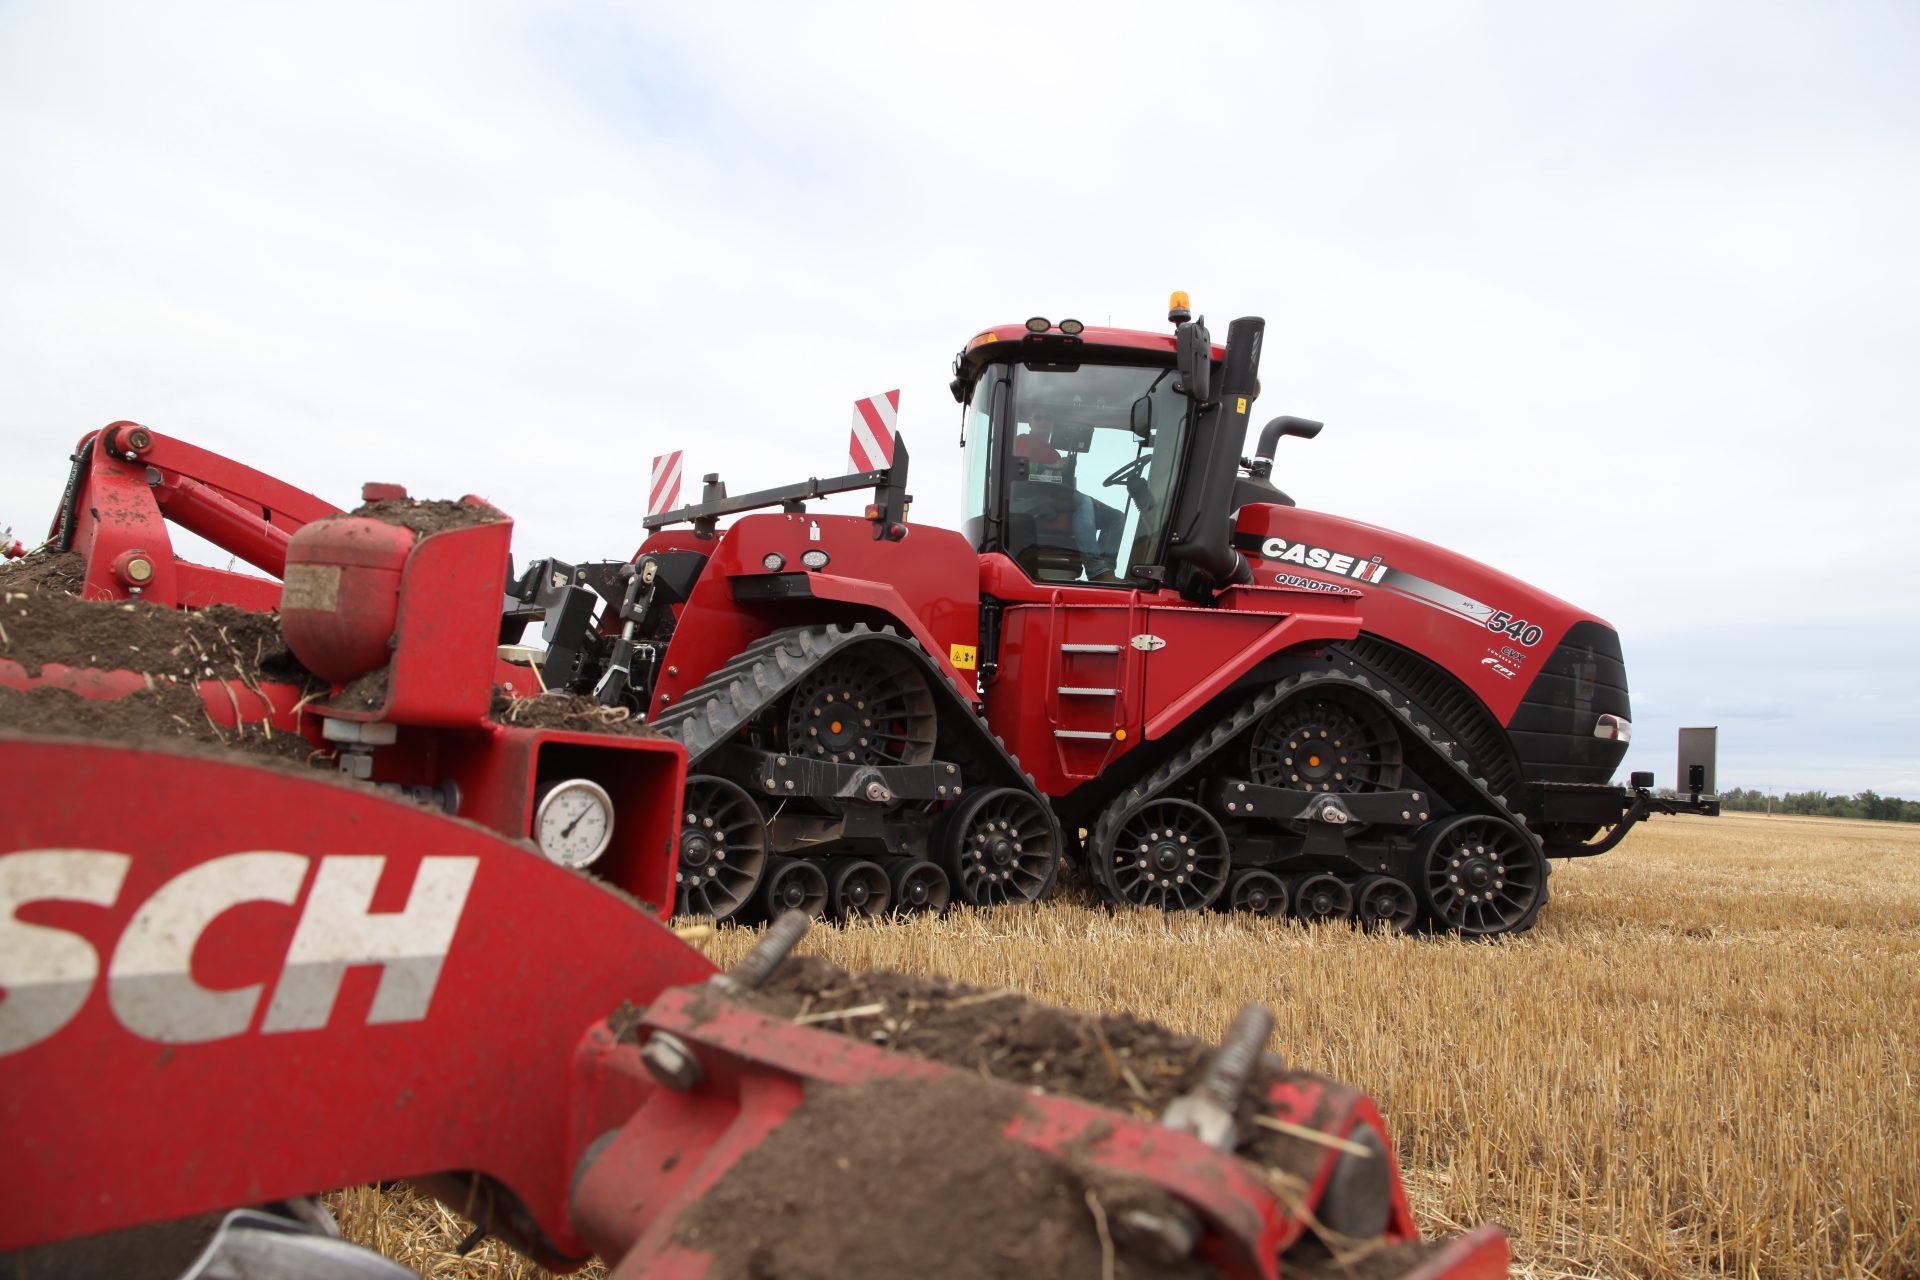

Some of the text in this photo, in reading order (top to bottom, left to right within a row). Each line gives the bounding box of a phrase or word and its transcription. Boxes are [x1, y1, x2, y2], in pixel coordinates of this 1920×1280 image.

[1262, 537, 1354, 574] CASE
[1487, 610, 1543, 647] 540
[1487, 648, 1512, 664] POWERED
[1501, 645, 1526, 662] CVX
[1493, 663, 1516, 677] FPT
[0, 848, 480, 1057] SCH
